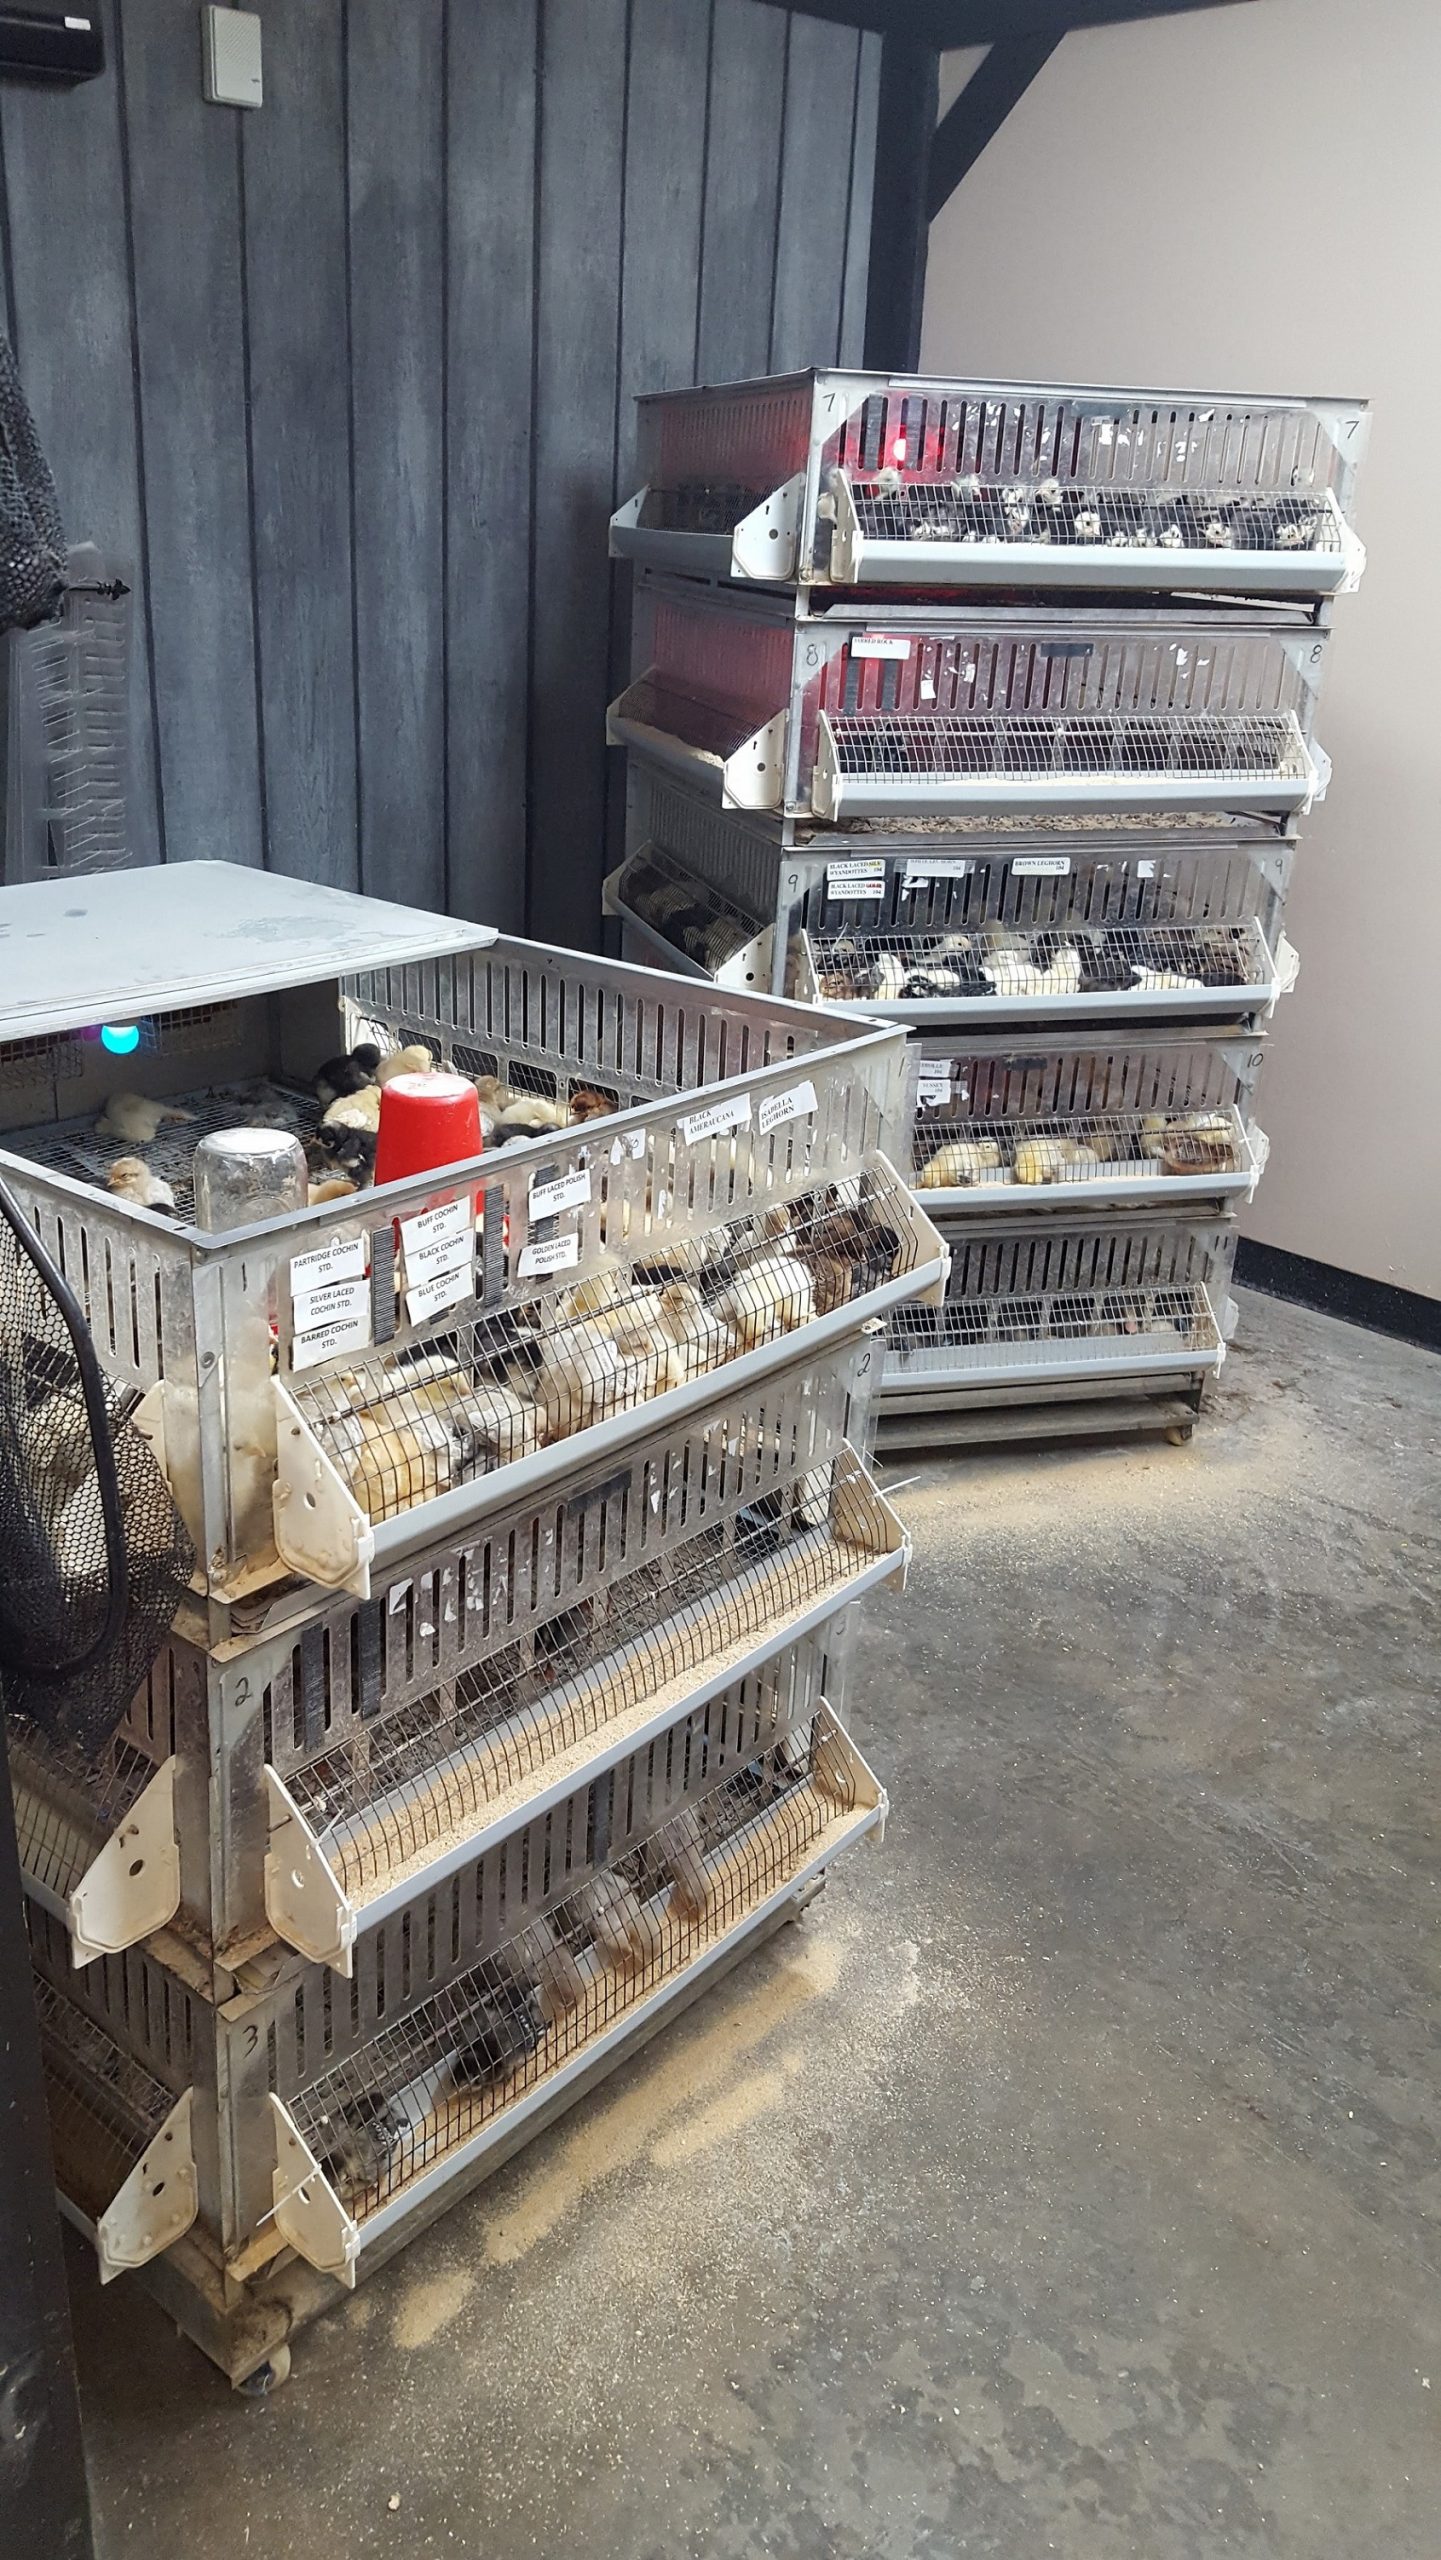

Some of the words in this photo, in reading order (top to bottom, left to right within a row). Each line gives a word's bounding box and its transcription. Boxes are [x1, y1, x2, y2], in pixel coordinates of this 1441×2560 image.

[822, 392, 836, 413] 7
[1345, 420, 1360, 439] 7
[806, 644, 818, 666] 8
[1310, 645, 1322, 664] 8
[1274, 859, 1282, 875] 9
[787, 874, 798, 893] 9
[1247, 1052, 1264, 1067] 10
[761, 1097, 793, 1119] ISABELLA
[761, 1105, 795, 1129] LEGHORN
[689, 1111, 711, 1125] BLACK
[532, 1187, 546, 1200] BUFF
[547, 1181, 565, 1194] LACED
[565, 1173, 586, 1186] POLISH
[553, 1192, 565, 1202] STD.
[417, 1215, 433, 1229] BUFF
[434, 1204, 458, 1220] COCHIN
[432, 1222, 447, 1233] STD.
[294, 1250, 331, 1269] PARTRIDGE
[332, 1242, 359, 1257] COCHIN
[418, 1245, 440, 1260] BLACK
[440, 1235, 465, 1252] COCHIN
[532, 1242, 555, 1255] GOLDEN
[554, 1238, 572, 1250] LACED
[535, 1253, 555, 1265] POLISH
[555, 1250, 567, 1261] STD.
[318, 1262, 334, 1273] STD.
[418, 1284, 435, 1298] BLUE
[435, 1272, 460, 1290] COCHIN
[309, 1291, 332, 1305] SILVER
[332, 1287, 355, 1298] LACED
[310, 1302, 336, 1316] COCHIN
[336, 1299, 353, 1309] STD.
[300, 1329, 330, 1345] BARRED
[330, 1319, 359, 1335] COCHIN
[321, 1338, 338, 1349] STD.
[857, 1353, 871, 1377] 2
[235, 1677, 251, 1706] 2
[242, 2024, 258, 2056] 3
